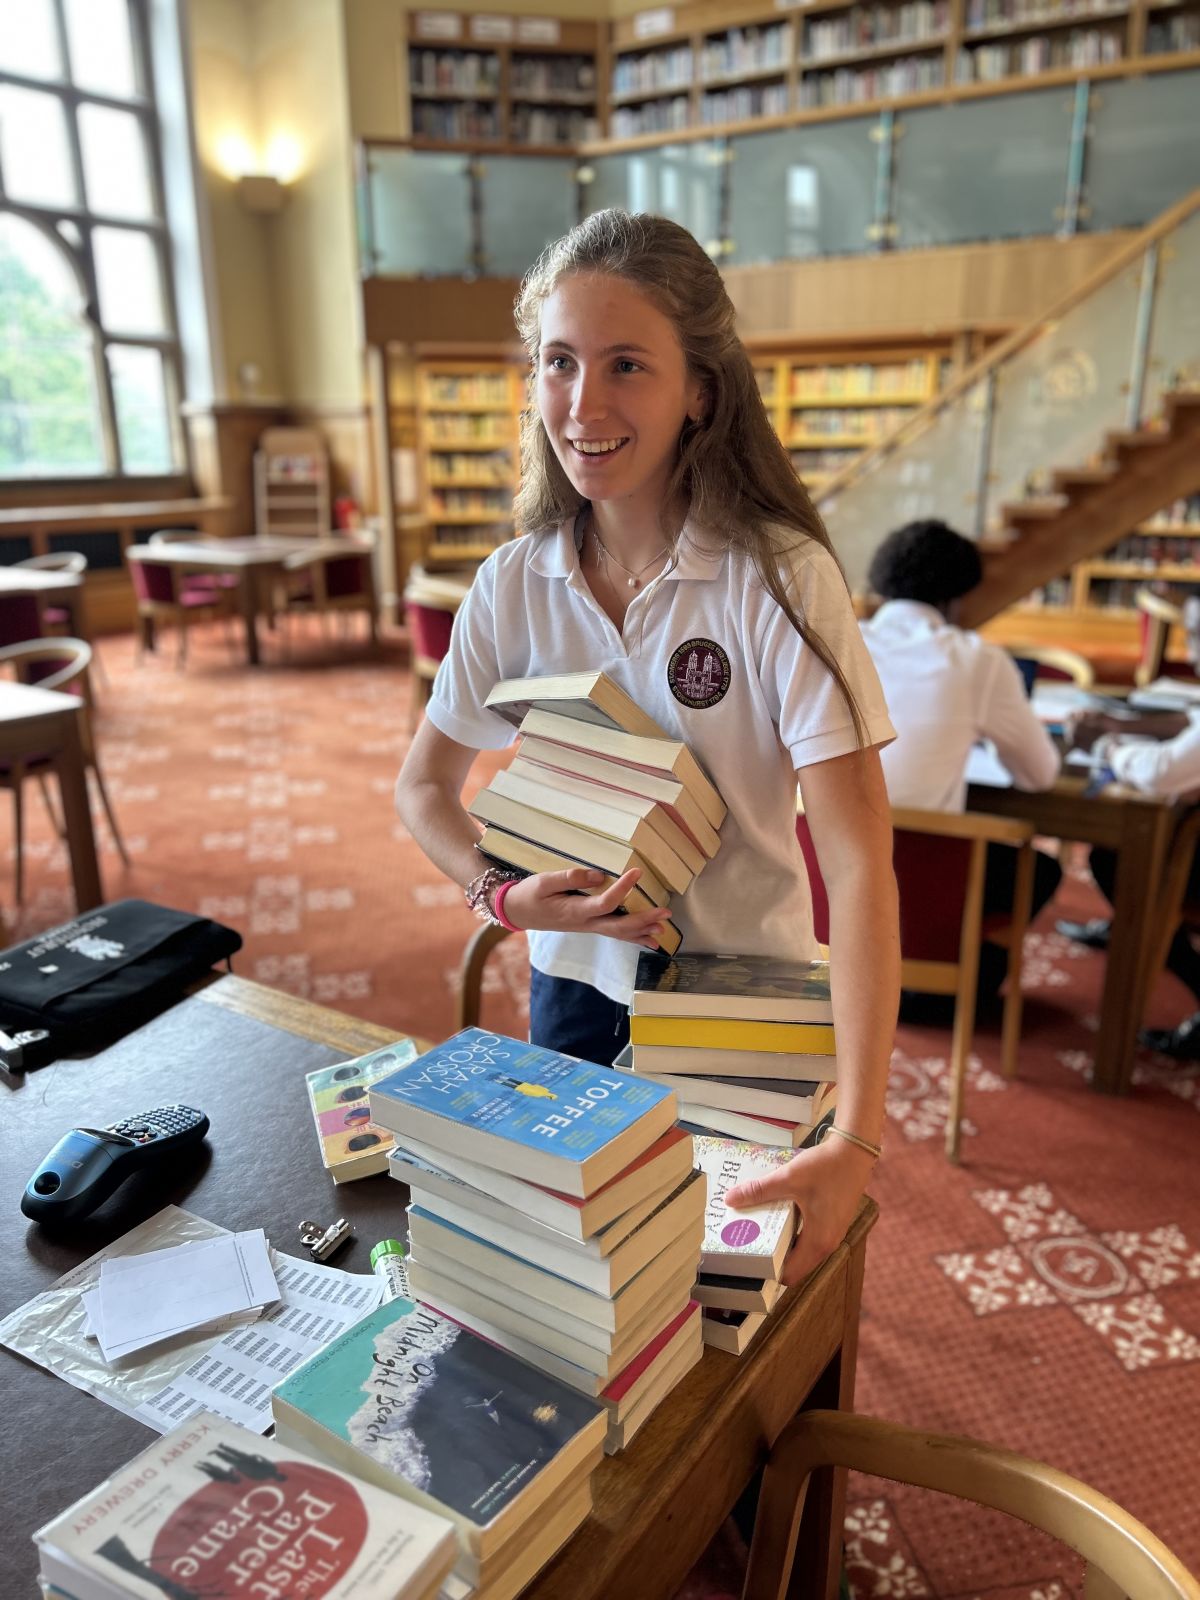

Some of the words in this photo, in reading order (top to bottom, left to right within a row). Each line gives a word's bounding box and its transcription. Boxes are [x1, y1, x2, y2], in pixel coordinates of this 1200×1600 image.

[394, 1036, 500, 1096] CROSSAN
[431, 1048, 510, 1094] SARAH
[531, 1078, 624, 1138] TOFFEE
[705, 1160, 742, 1234] BEAUTY
[373, 1312, 440, 1389] Midnight
[409, 1362, 433, 1384] On
[159, 1424, 211, 1468] KERRY
[365, 1393, 407, 1444] Beach
[72, 1466, 158, 1536] DREWERY
[171, 1485, 284, 1578] Crane
[226, 1489, 337, 1586] Paper
[250, 1524, 344, 1600] Last
[295, 1558, 340, 1592] The
